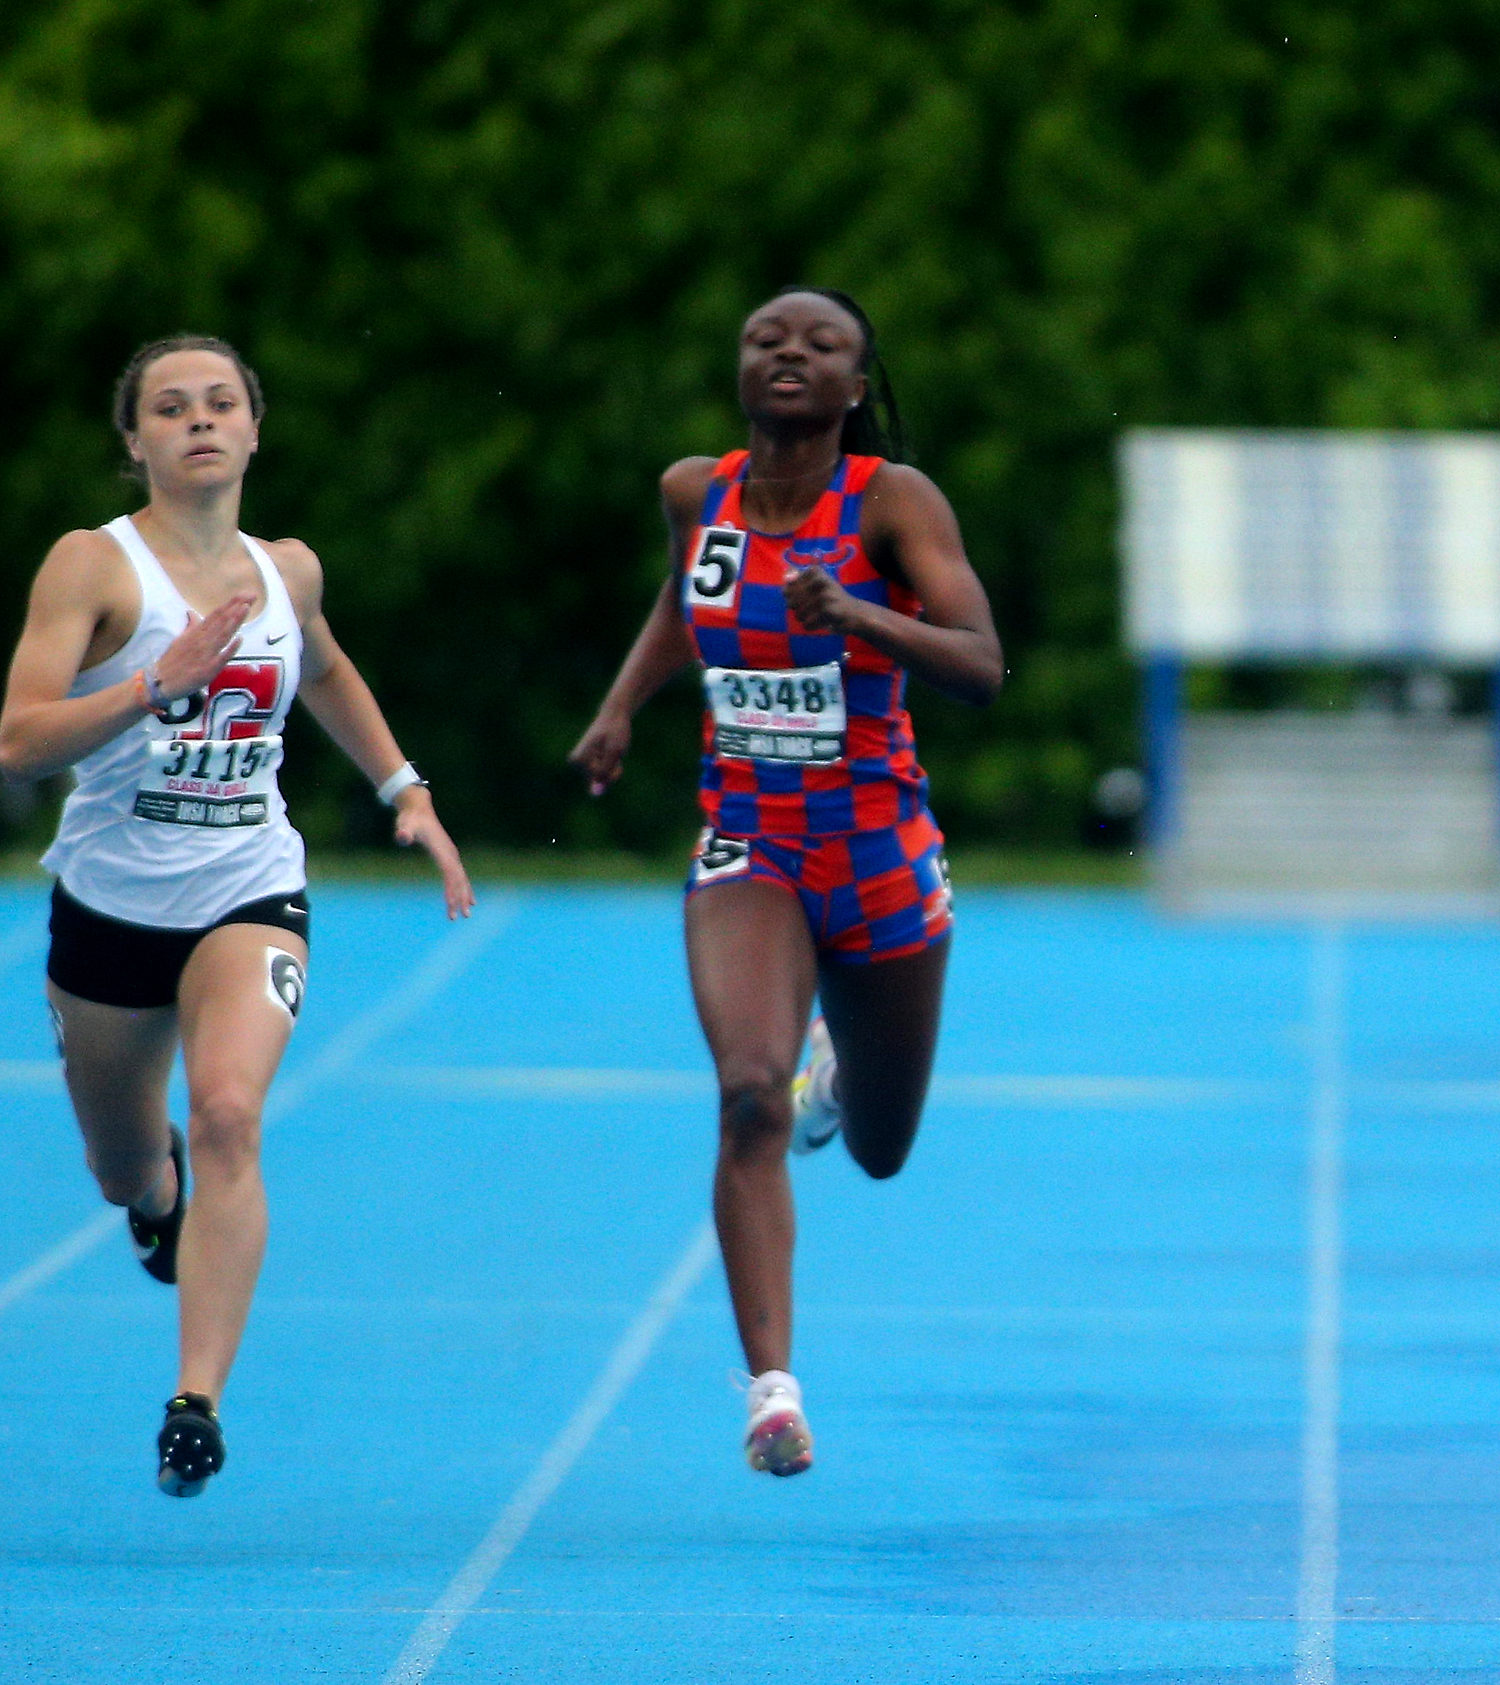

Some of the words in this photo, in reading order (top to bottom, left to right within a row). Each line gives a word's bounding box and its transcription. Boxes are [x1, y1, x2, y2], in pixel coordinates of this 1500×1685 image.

[694, 534, 738, 597] 5
[722, 673, 825, 712] 3348
[163, 741, 268, 781] 3115
[271, 954, 304, 1017] 6
